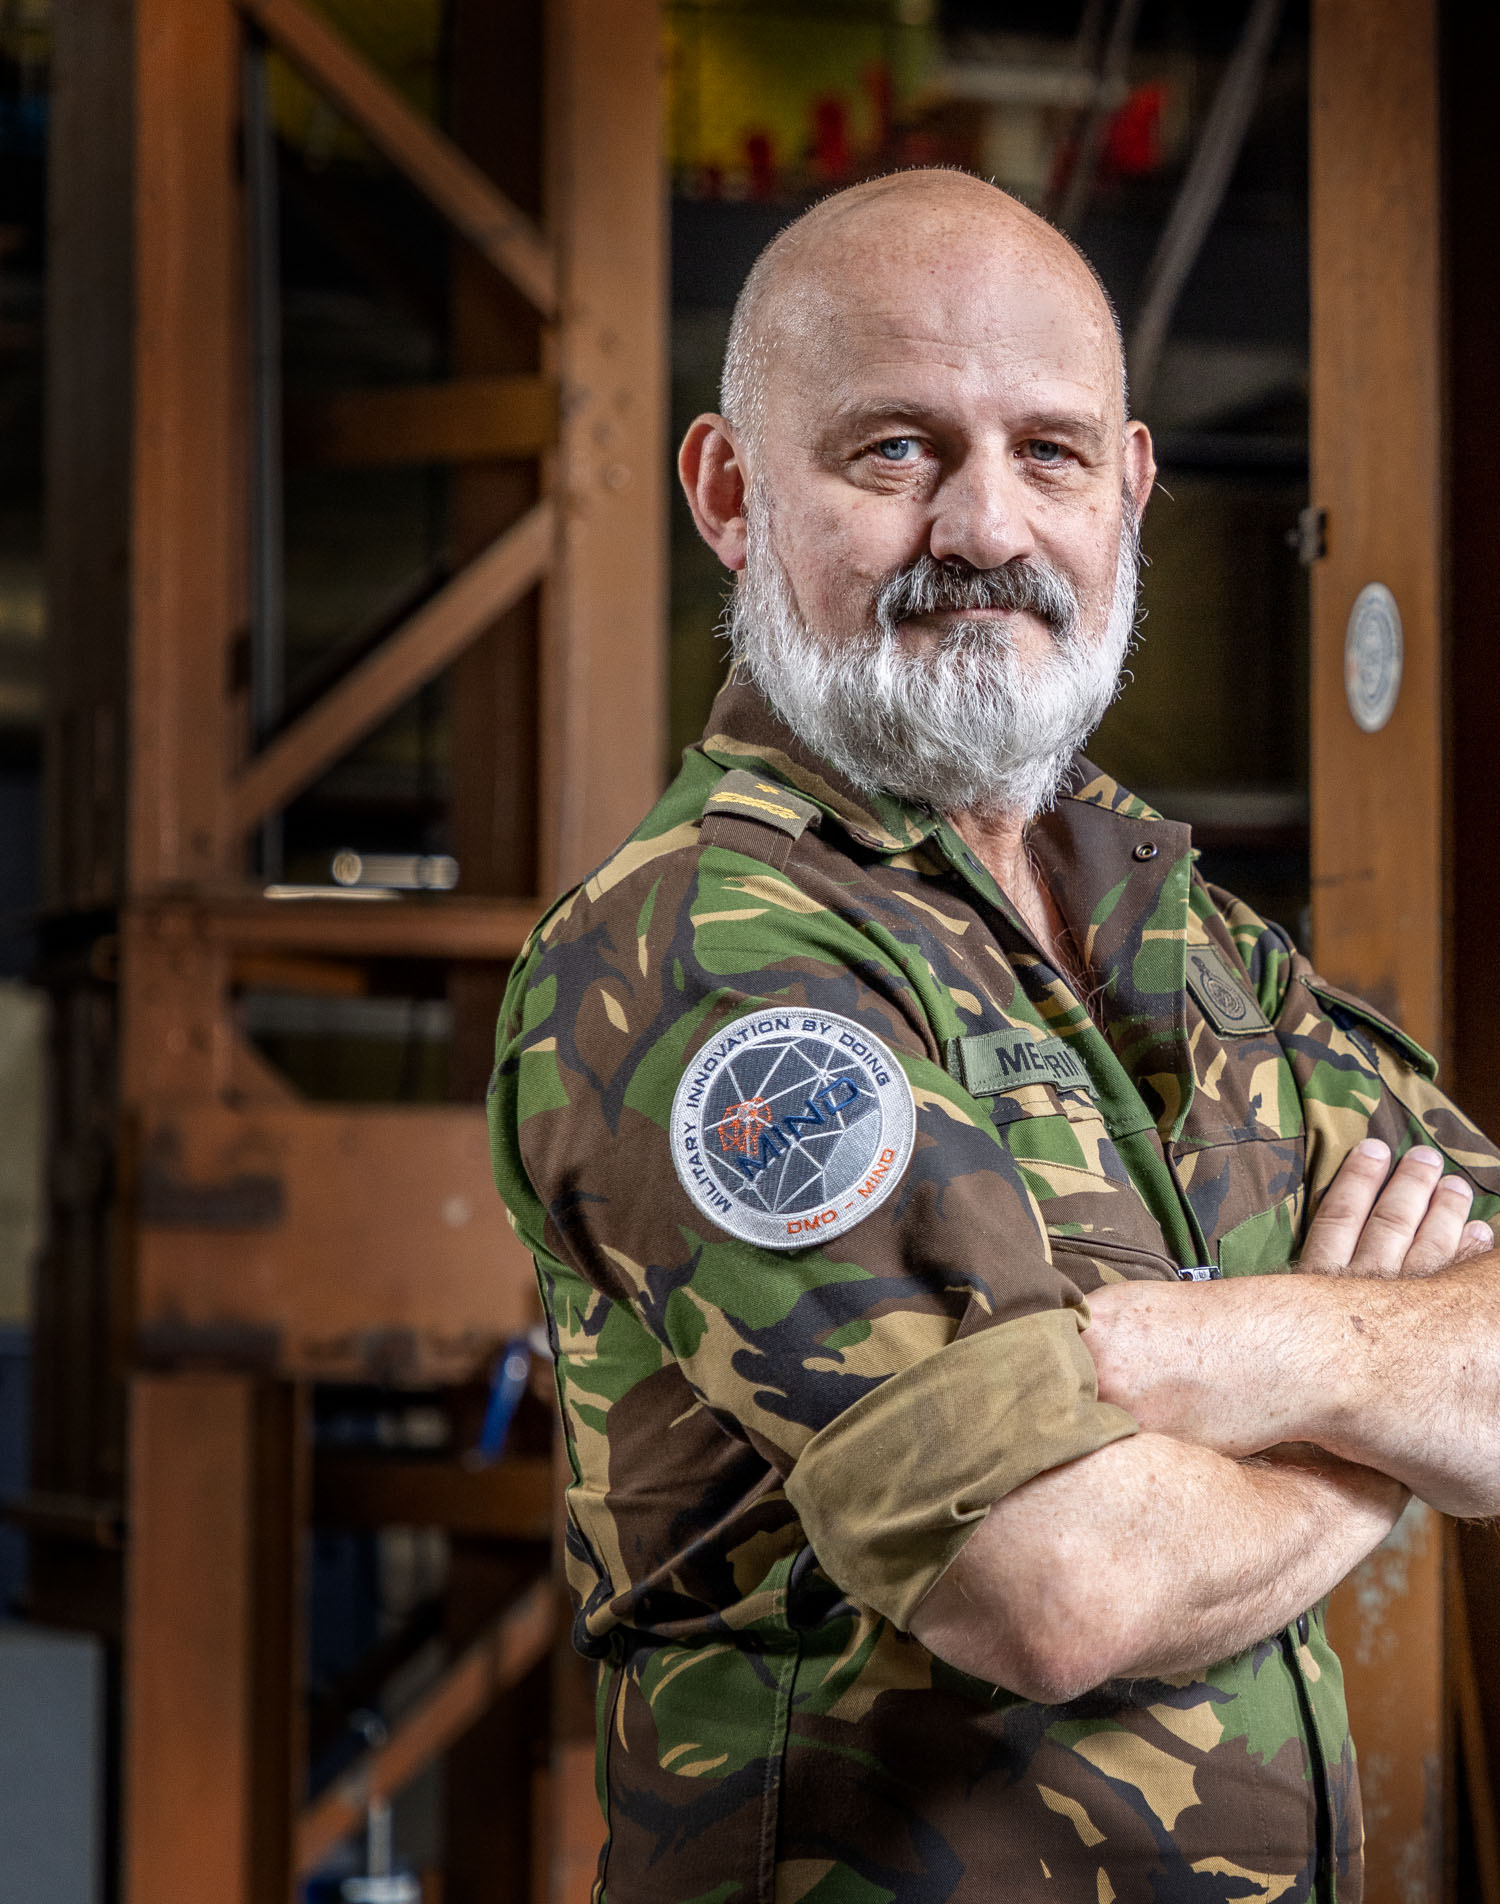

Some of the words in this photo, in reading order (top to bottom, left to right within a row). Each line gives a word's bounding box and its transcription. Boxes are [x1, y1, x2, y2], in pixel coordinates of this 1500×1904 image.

[687, 1018, 790, 1108] INNOVATION
[802, 1019, 832, 1035] BY
[839, 1032, 890, 1087] DOING
[682, 1123, 732, 1213] MILITARY
[736, 1077, 859, 1179] MIND
[787, 1210, 838, 1234] DMO
[857, 1148, 895, 1198] MIND
